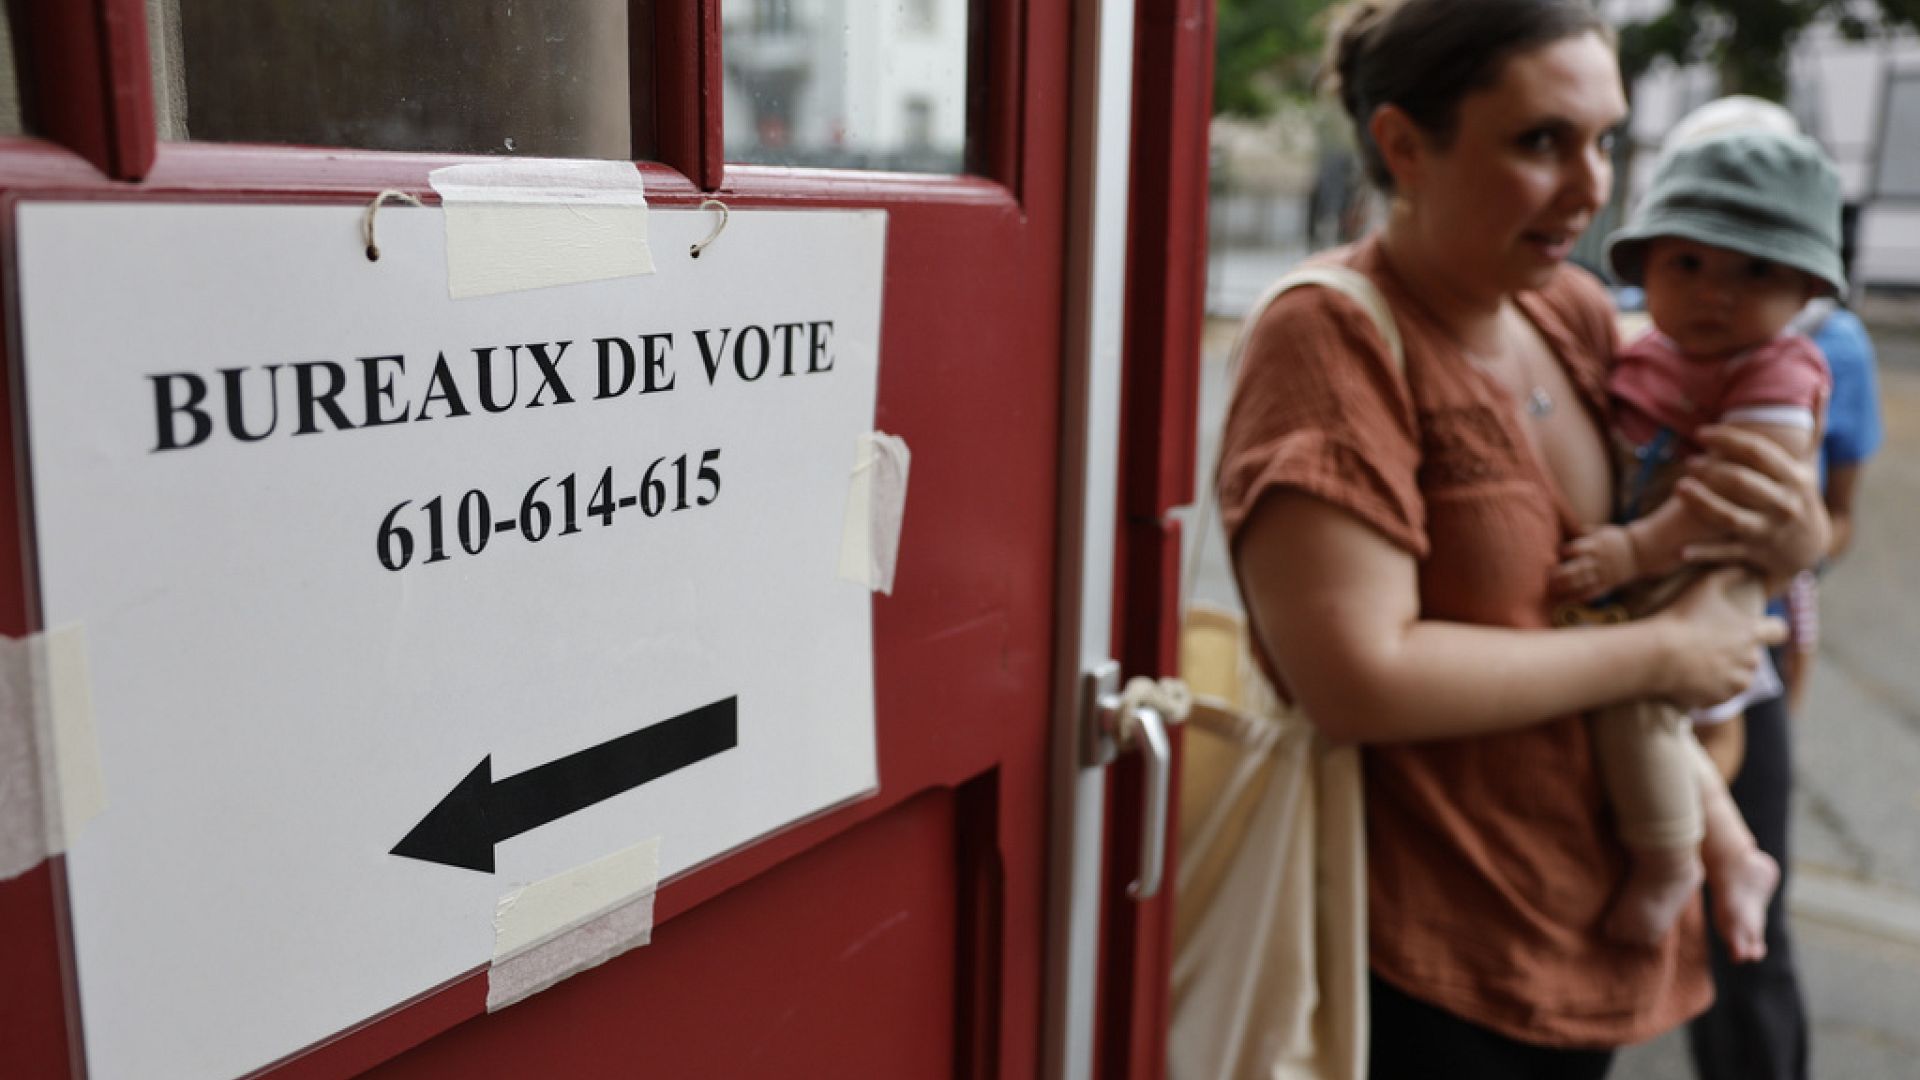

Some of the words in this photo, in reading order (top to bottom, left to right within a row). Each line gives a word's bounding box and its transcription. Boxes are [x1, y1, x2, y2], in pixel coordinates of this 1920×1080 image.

[147, 339, 577, 454] BUREAUX
[592, 332, 677, 401] DE
[692, 320, 835, 387] VOTE
[375, 447, 723, 573] 610-614-615
